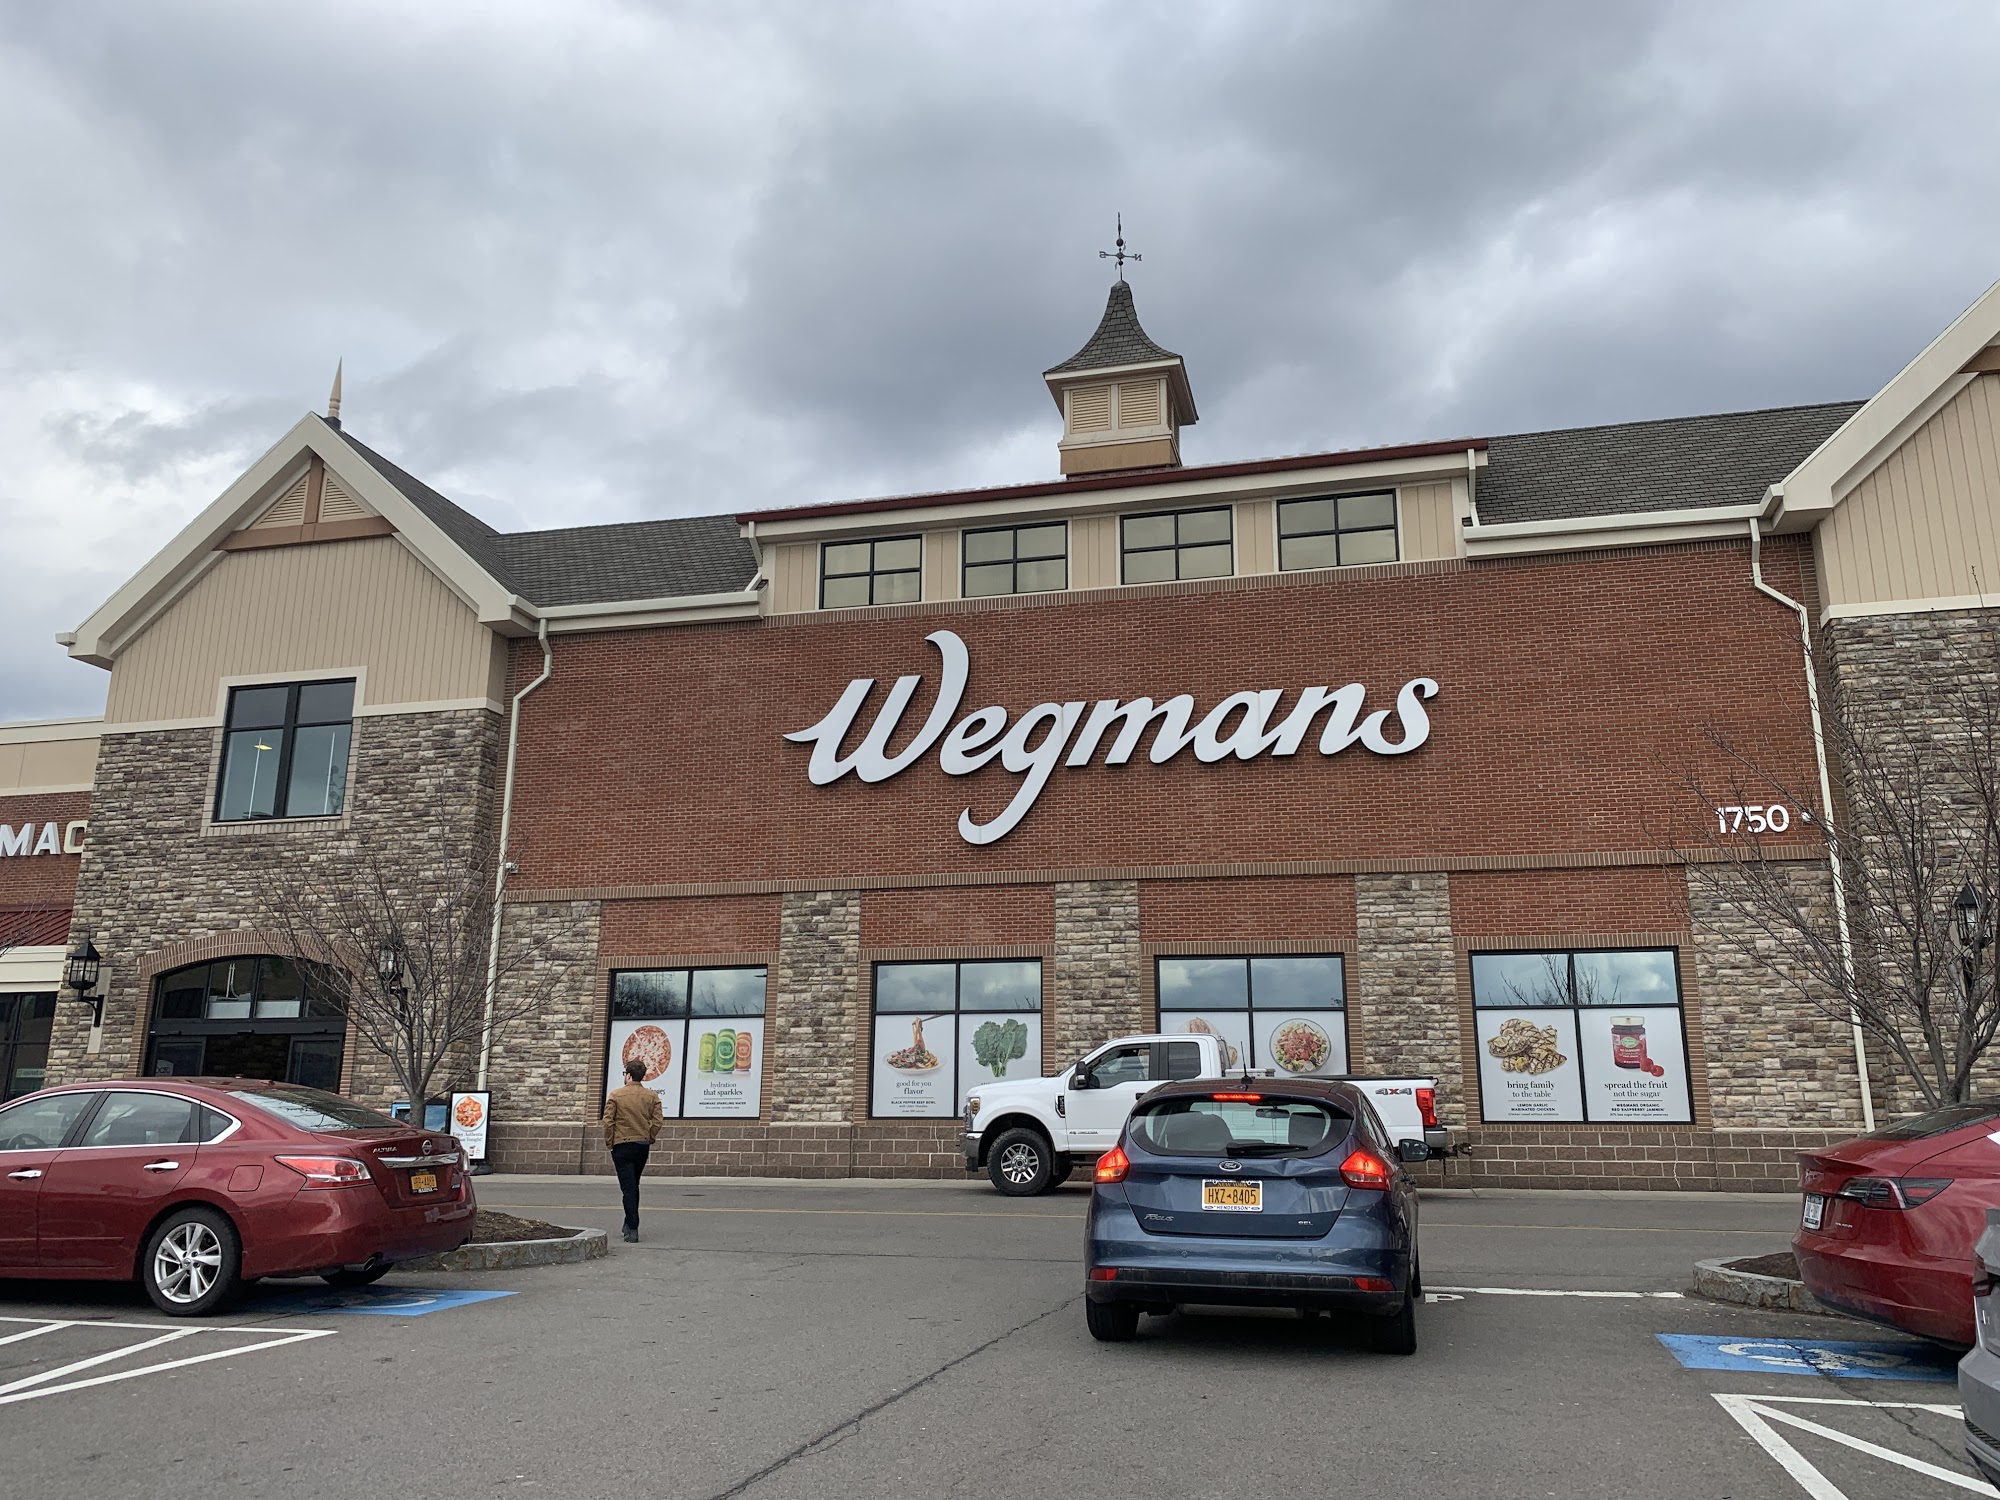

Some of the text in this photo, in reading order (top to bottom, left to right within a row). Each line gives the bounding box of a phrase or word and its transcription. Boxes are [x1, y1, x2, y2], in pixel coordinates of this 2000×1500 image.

[783, 629, 1439, 846] Wegmans
[1715, 804, 1790, 834] 1750
[710, 1081, 737, 1089] hydration
[896, 1080, 911, 1088] good
[1507, 1080, 1555, 1090] bring family
[1604, 1080, 1668, 1090] spread the fruit
[703, 1088, 743, 1097] that sparkles
[903, 1087, 924, 1095] flavor
[1521, 1090, 1533, 1098] the
[1534, 1090, 1552, 1098] table
[1627, 1089, 1639, 1097] the
[1640, 1091, 1661, 1099] sugar
